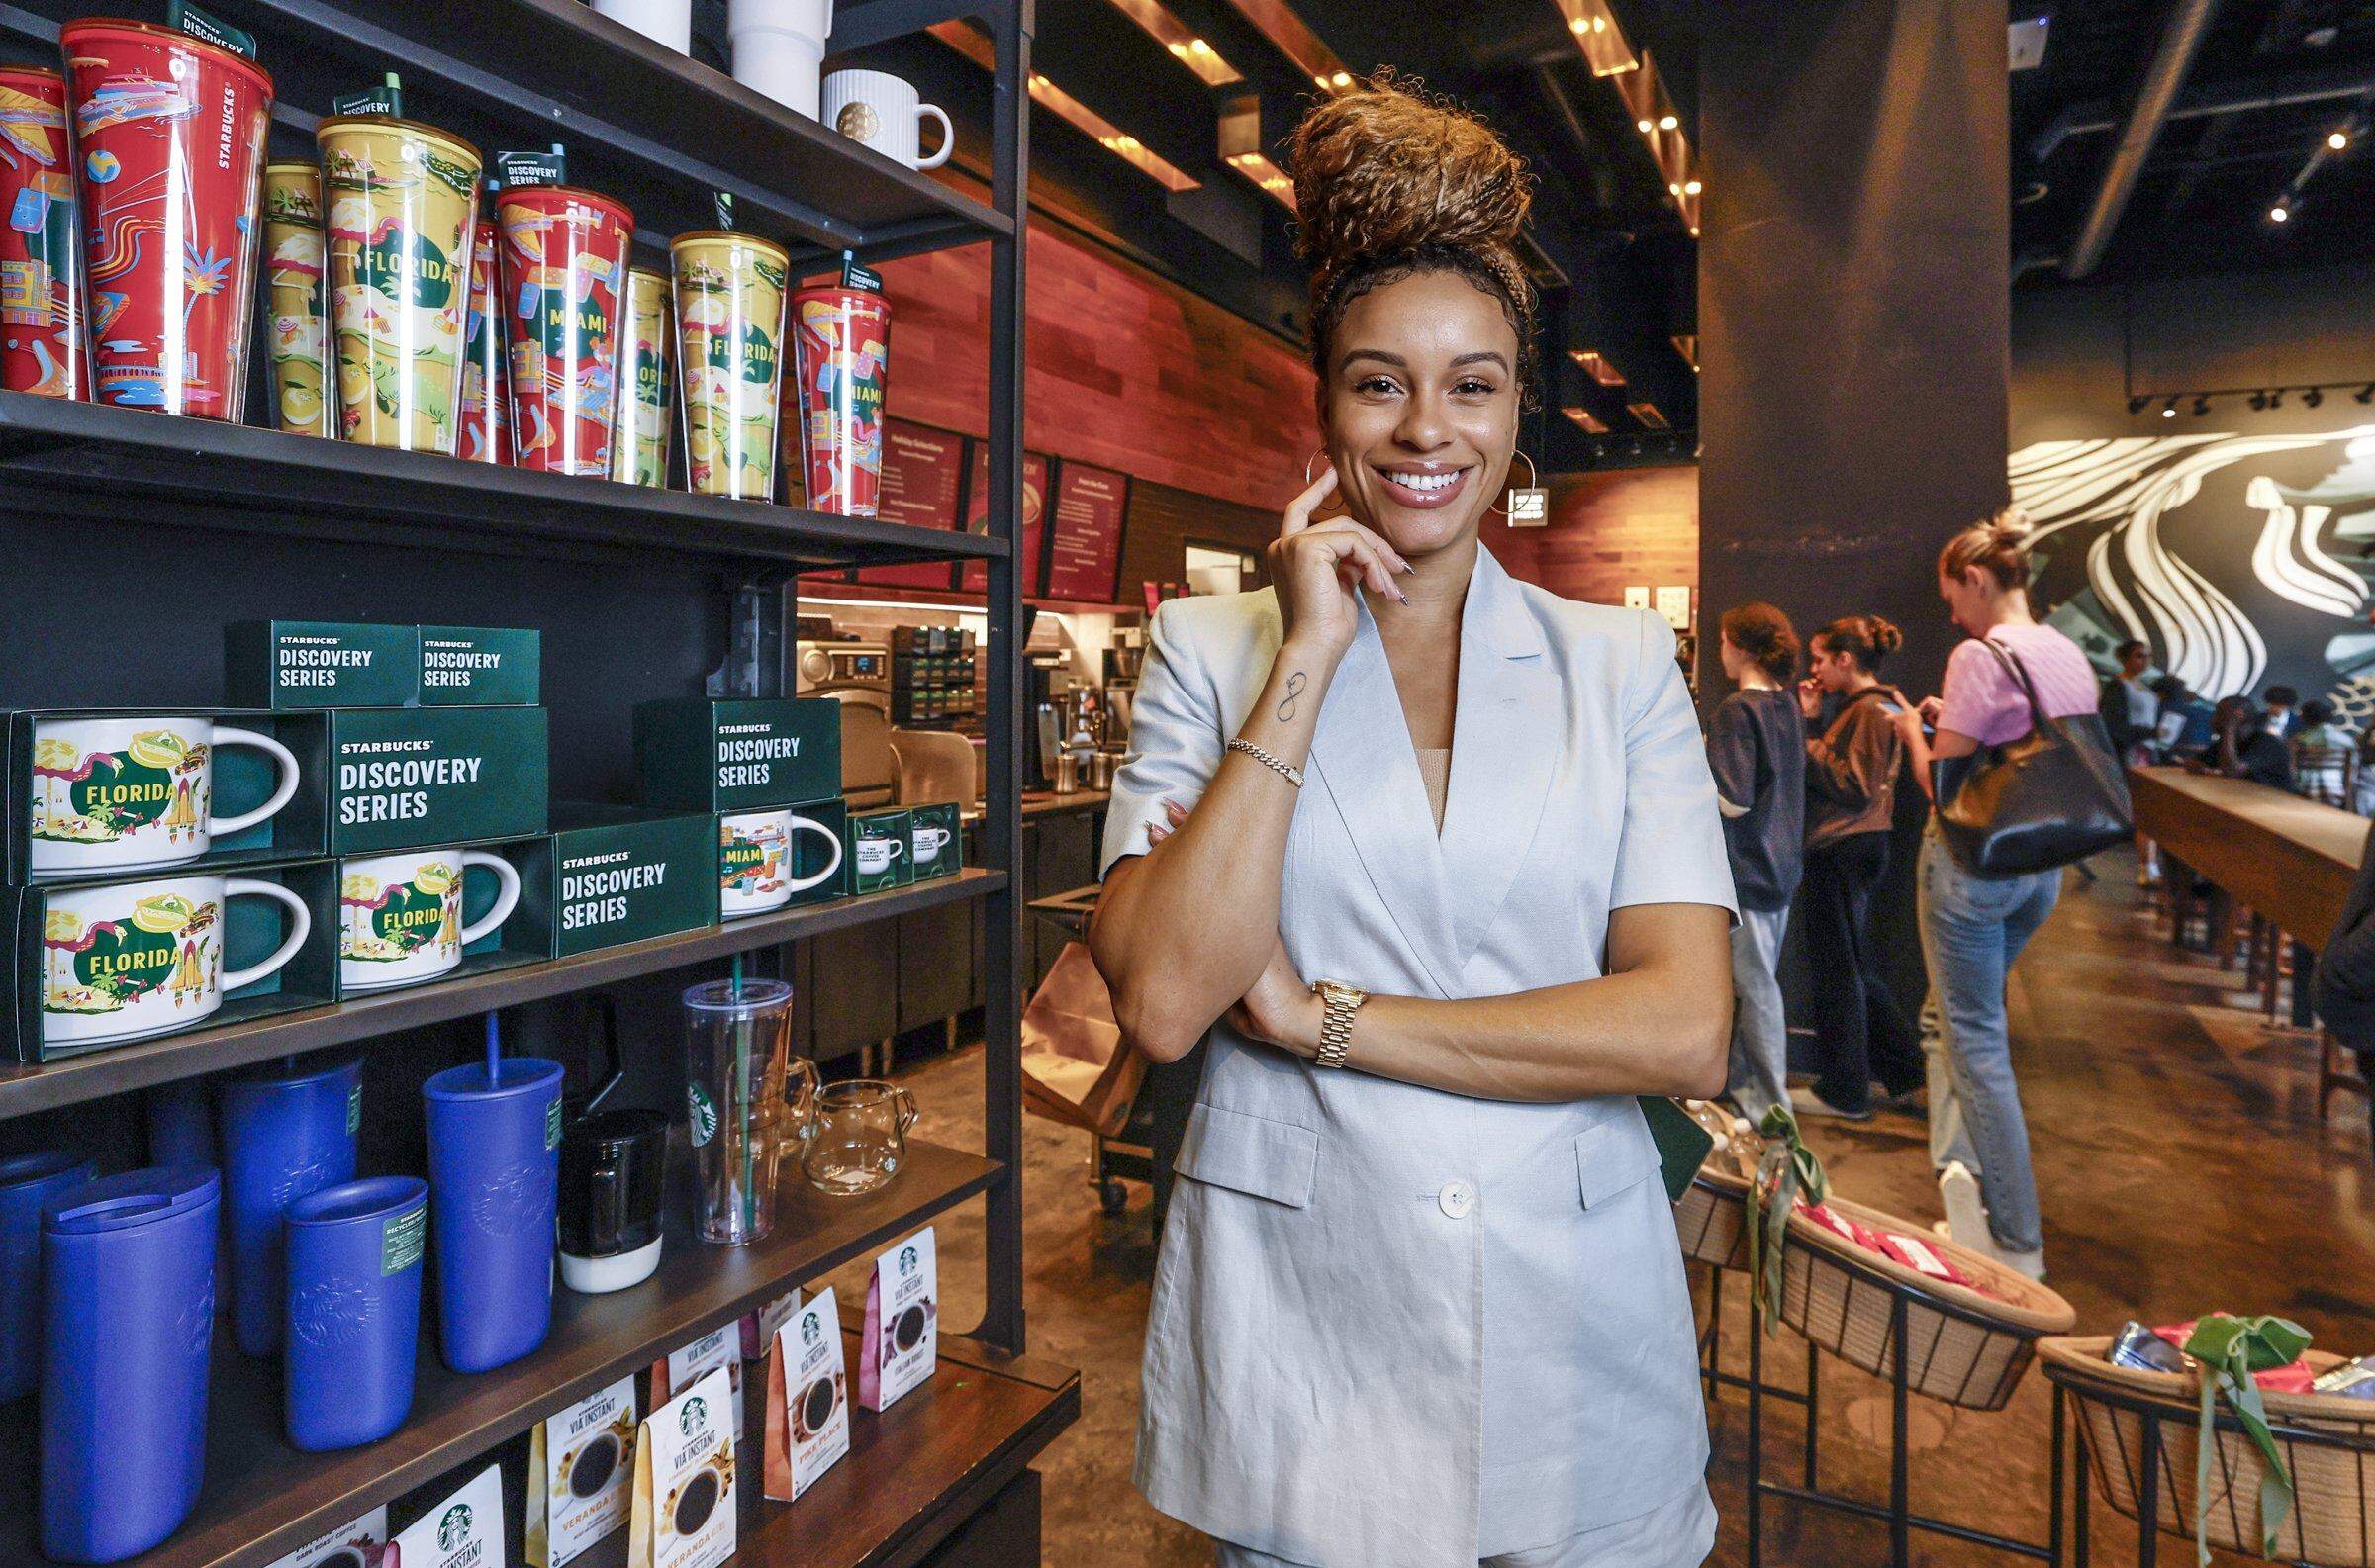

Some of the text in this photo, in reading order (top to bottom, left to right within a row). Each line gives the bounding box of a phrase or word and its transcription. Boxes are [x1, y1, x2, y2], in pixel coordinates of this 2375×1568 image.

[216, 85, 235, 170] STARBUCKS
[507, 166, 558, 178] DISCOVERY
[549, 308, 607, 334] MAMI
[714, 339, 774, 363] FLRIDA
[279, 636, 340, 645] STARBUCKS
[279, 649, 373, 667] DISCOVERY
[424, 652, 501, 669] DISCOVERY
[279, 669, 336, 687] SERIES
[424, 671, 471, 687] SERIES
[718, 723, 771, 734] STARBUCKS
[340, 740, 433, 754] STARBUCKS
[718, 737, 800, 763] DISCOVERY
[339, 757, 482, 791] DISCOVERY
[718, 763, 770, 788] SERIES
[86, 783, 177, 805] FLORIDA
[339, 790, 428, 825] SERIES
[562, 852, 630, 870] STARBUCKS
[562, 862, 666, 901] DISCOVERY
[383, 906, 446, 929] FLORIDA
[562, 896, 627, 930] SERIES
[90, 947, 181, 974] FLORIDA
[585, 1397, 616, 1427] INSTANT
[688, 1430, 715, 1461] INSTANT
[563, 1497, 610, 1531] VERANDA
[447, 1538, 483, 1568] NSTANT
